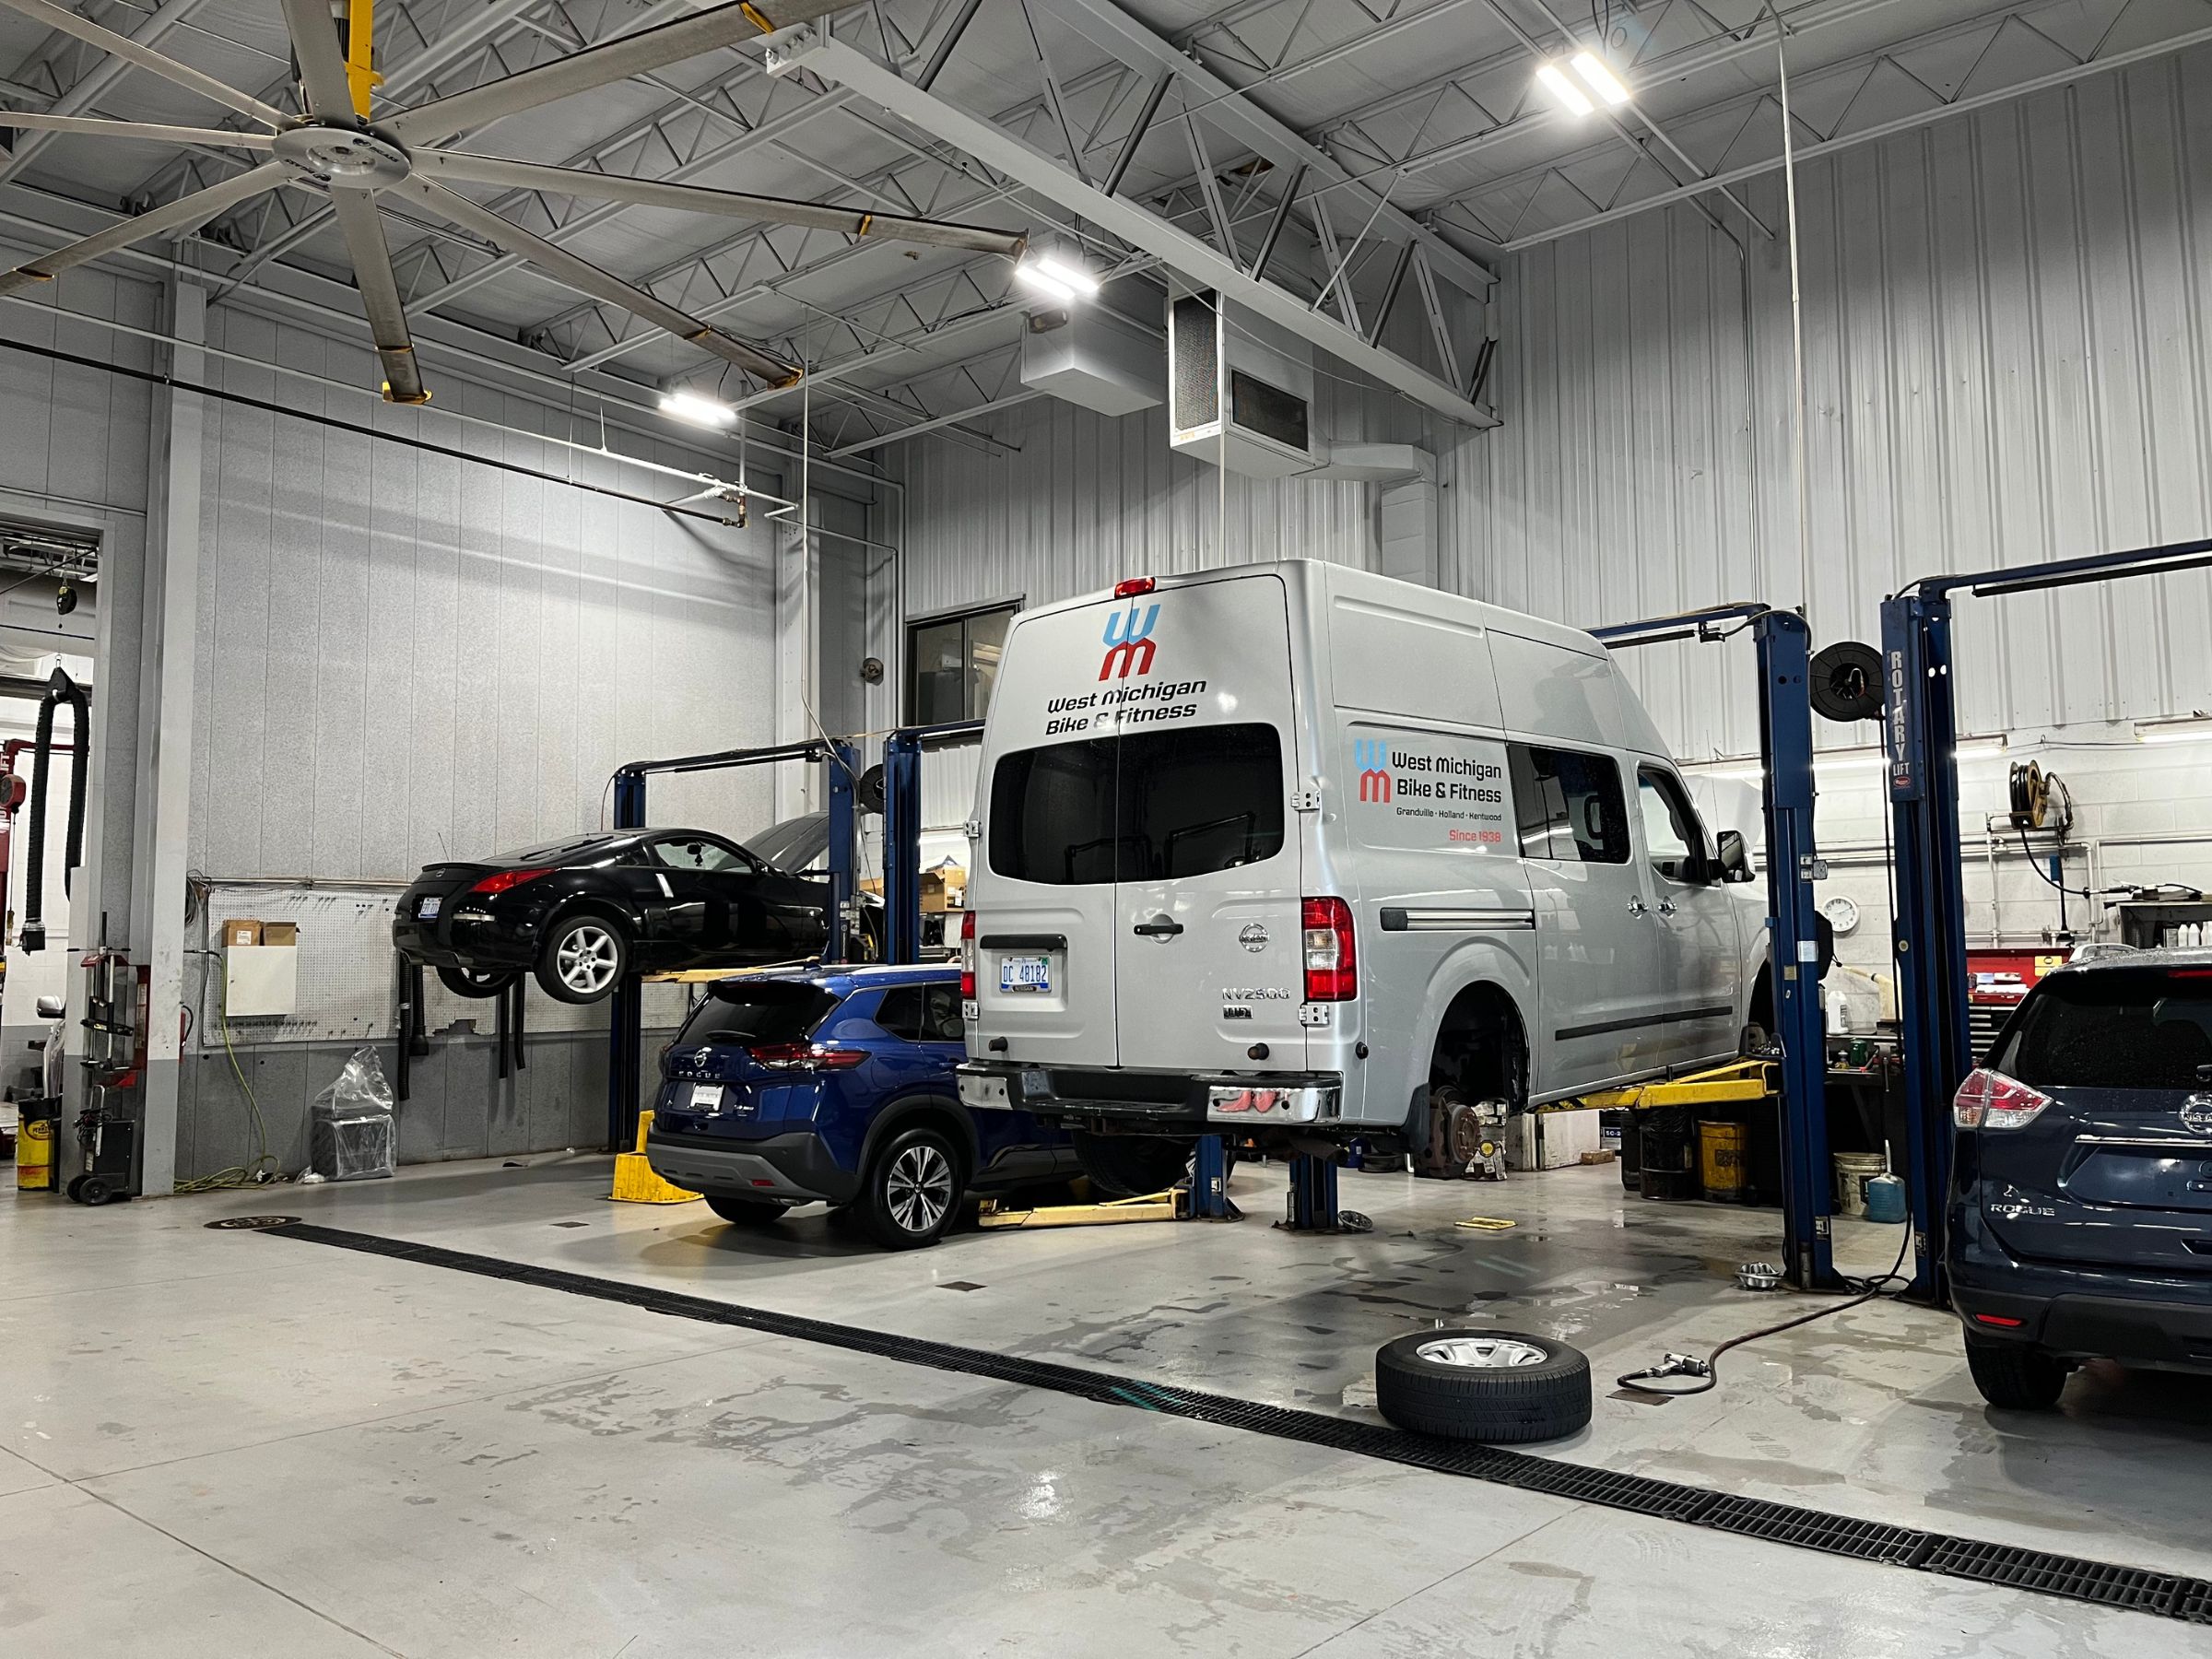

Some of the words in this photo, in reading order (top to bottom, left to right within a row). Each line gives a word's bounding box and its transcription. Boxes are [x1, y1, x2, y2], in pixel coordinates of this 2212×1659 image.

[1047, 693, 1098, 713] West
[1101, 680, 1207, 705] Michigan
[1891, 651, 1906, 761] ROTARY
[1045, 717, 1088, 735] Bike
[1093, 712, 1109, 728] &
[1114, 703, 1197, 725] Fitness
[1393, 751, 1431, 771] West
[1436, 756, 1501, 781] Michigan
[1893, 762, 1910, 776] LIFT
[1397, 779, 1431, 797] Bike
[1435, 782, 1446, 798] &
[1450, 783, 1501, 803] Fitness
[1439, 810, 1465, 819] Holland
[1468, 812, 1501, 821] Kentwood
[1449, 830, 1477, 841] Since
[1478, 830, 1501, 842] 1938
[1003, 965, 1013, 982] DC
[1019, 965, 1047, 982] 48182
[1222, 987, 1290, 1000] NV2500
[1991, 1204, 2055, 1216] ROGUE
